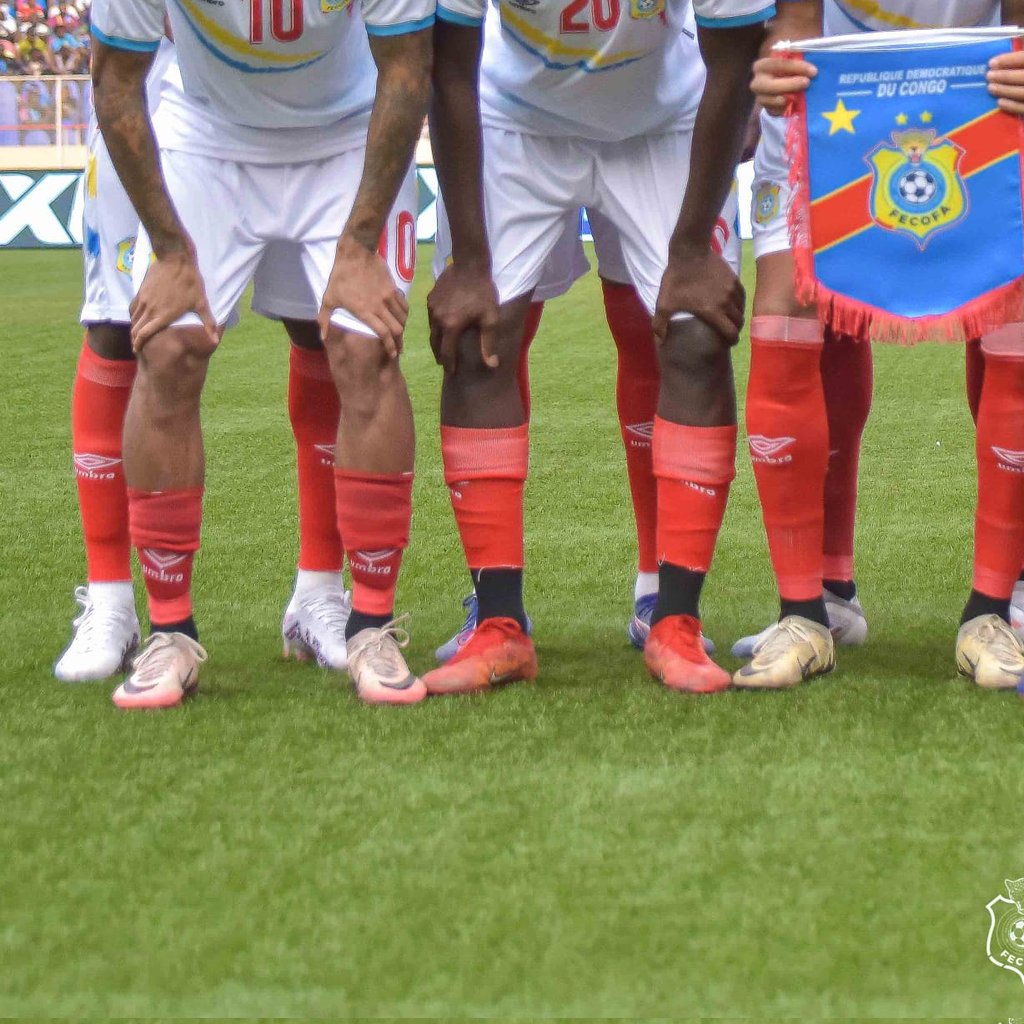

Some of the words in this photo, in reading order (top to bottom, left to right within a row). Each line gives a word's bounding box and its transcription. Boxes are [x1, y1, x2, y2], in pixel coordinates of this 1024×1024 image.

[839, 70, 904, 84] REPUBLIQUE
[877, 83, 896, 97] DU
[899, 79, 946, 96] CONGO
[889, 205, 951, 227] FECOFA
[142, 565, 184, 582] umbro
[350, 560, 391, 574] umbro
